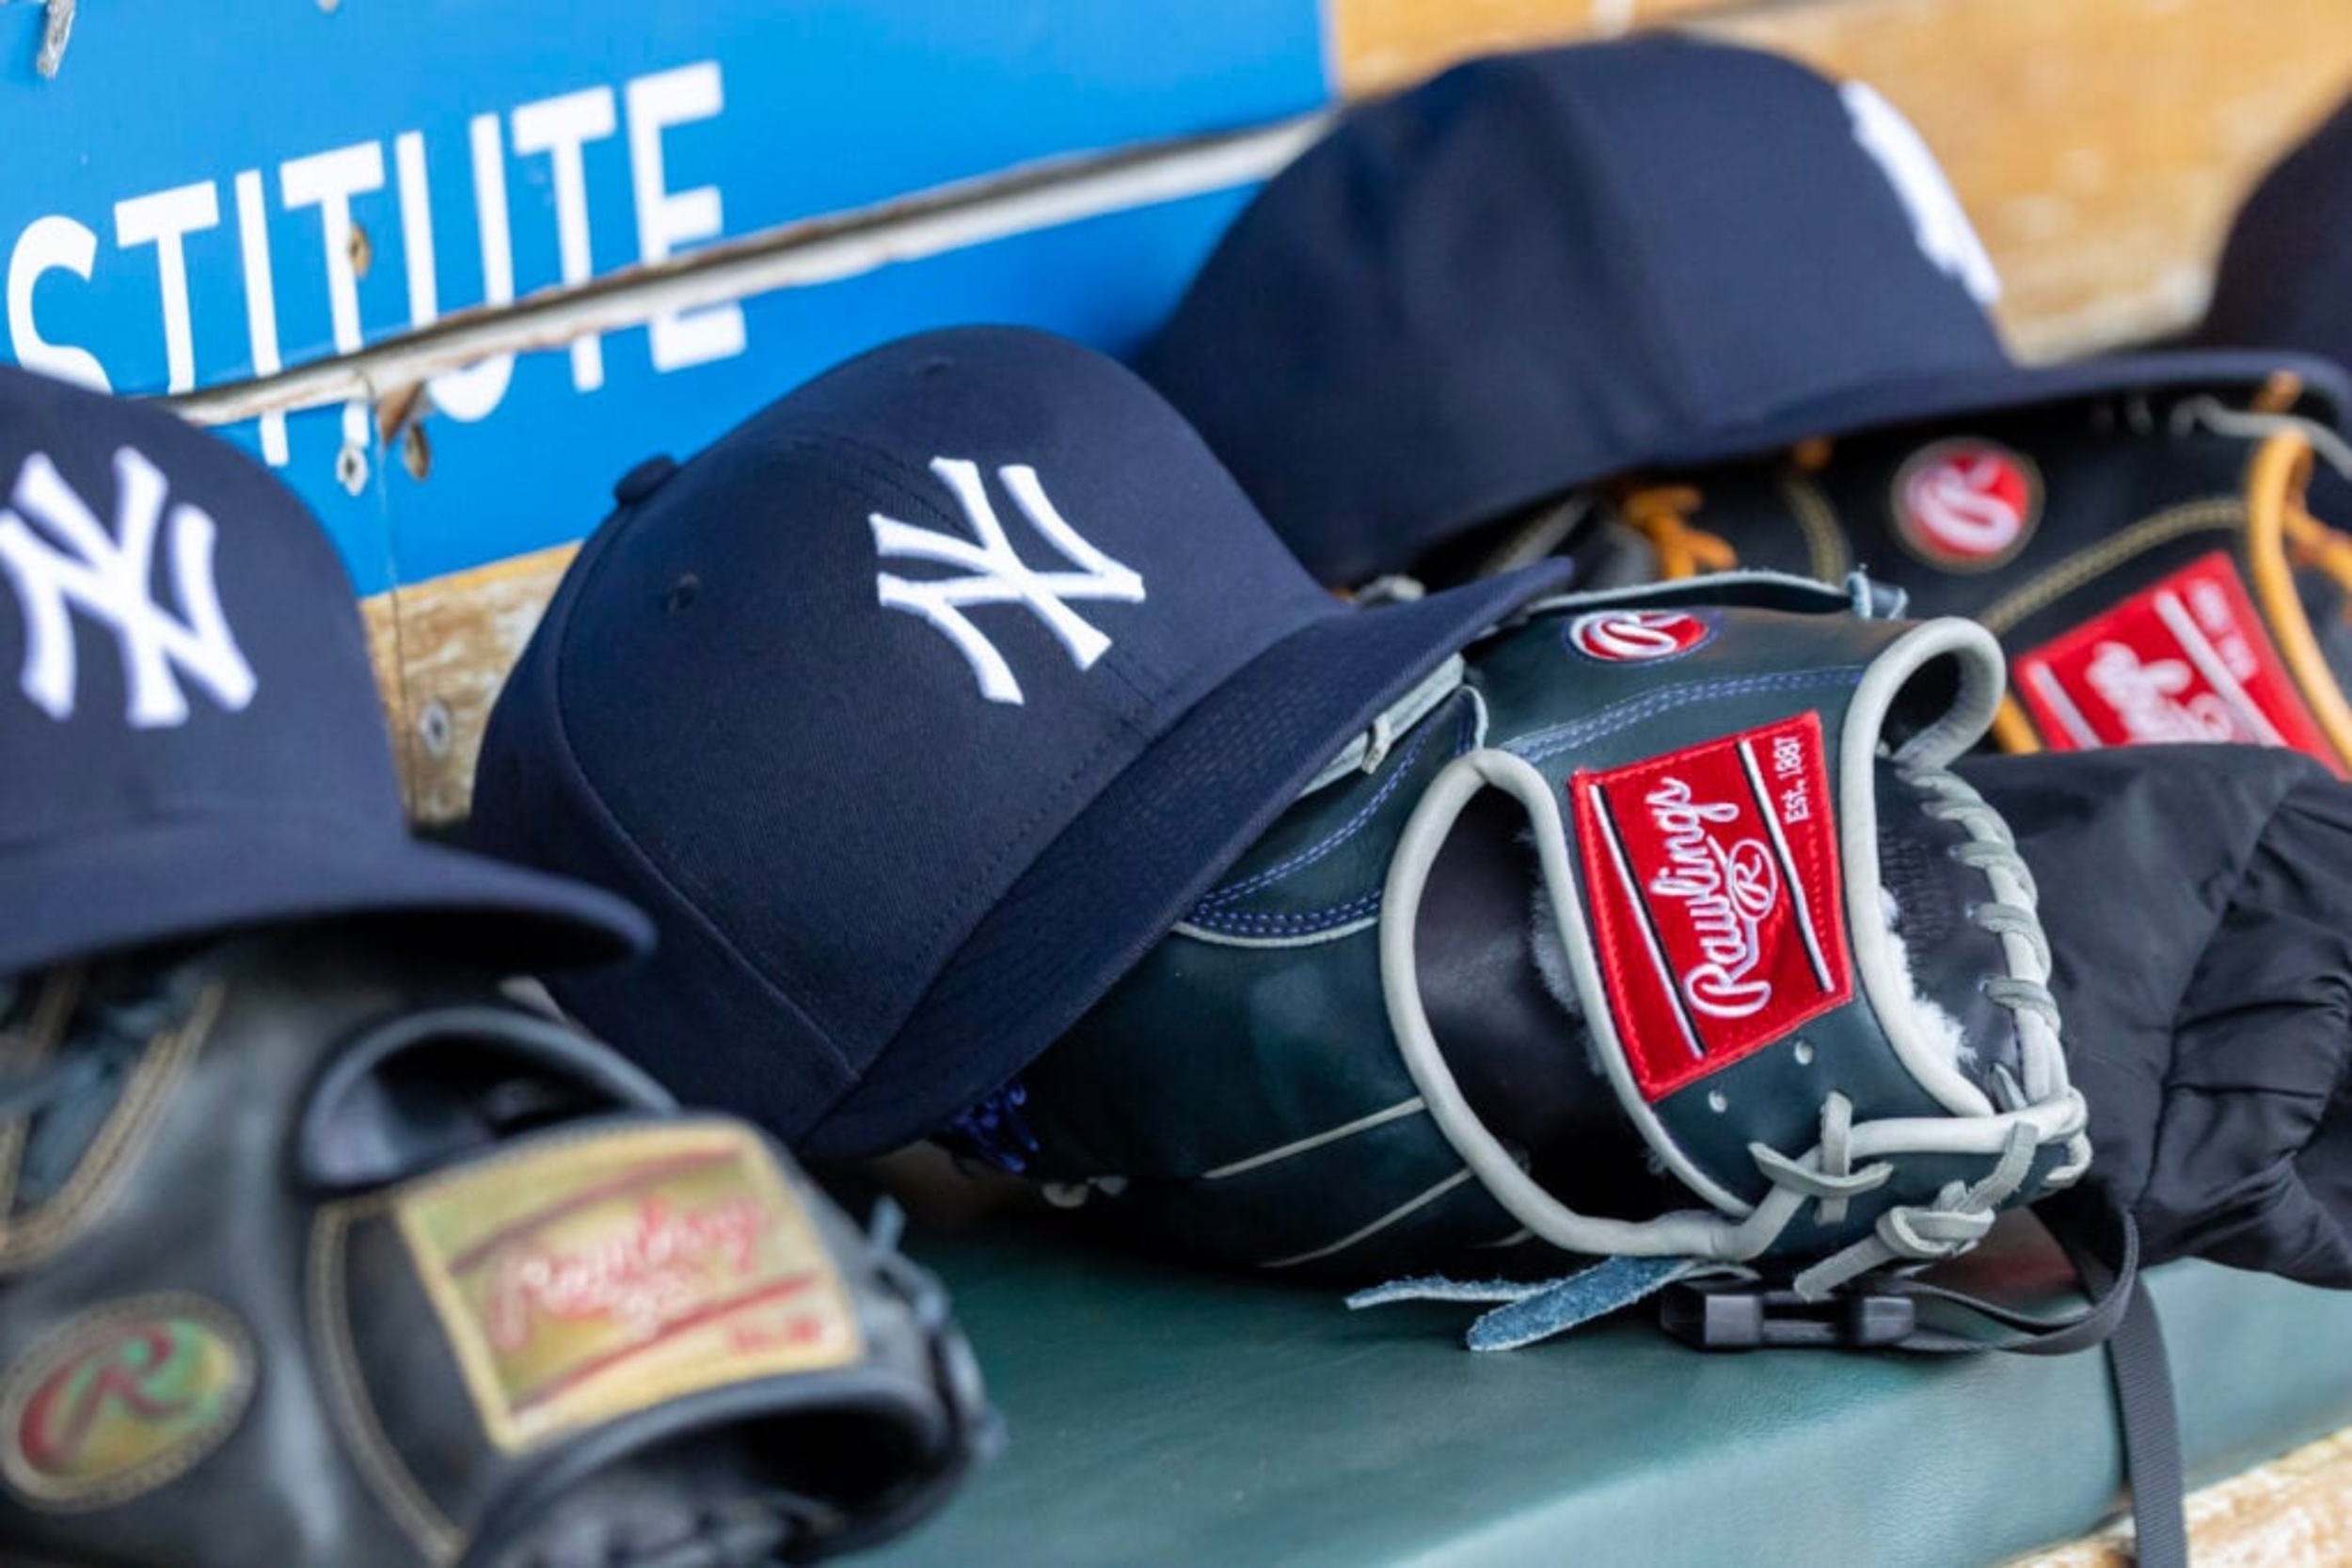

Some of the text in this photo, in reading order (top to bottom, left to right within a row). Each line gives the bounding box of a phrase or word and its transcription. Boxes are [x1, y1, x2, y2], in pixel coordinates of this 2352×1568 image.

[867, 455, 1147, 705] NY
[1772, 736, 1804, 781] 1887
[1645, 777, 1772, 1018] Rawlings
